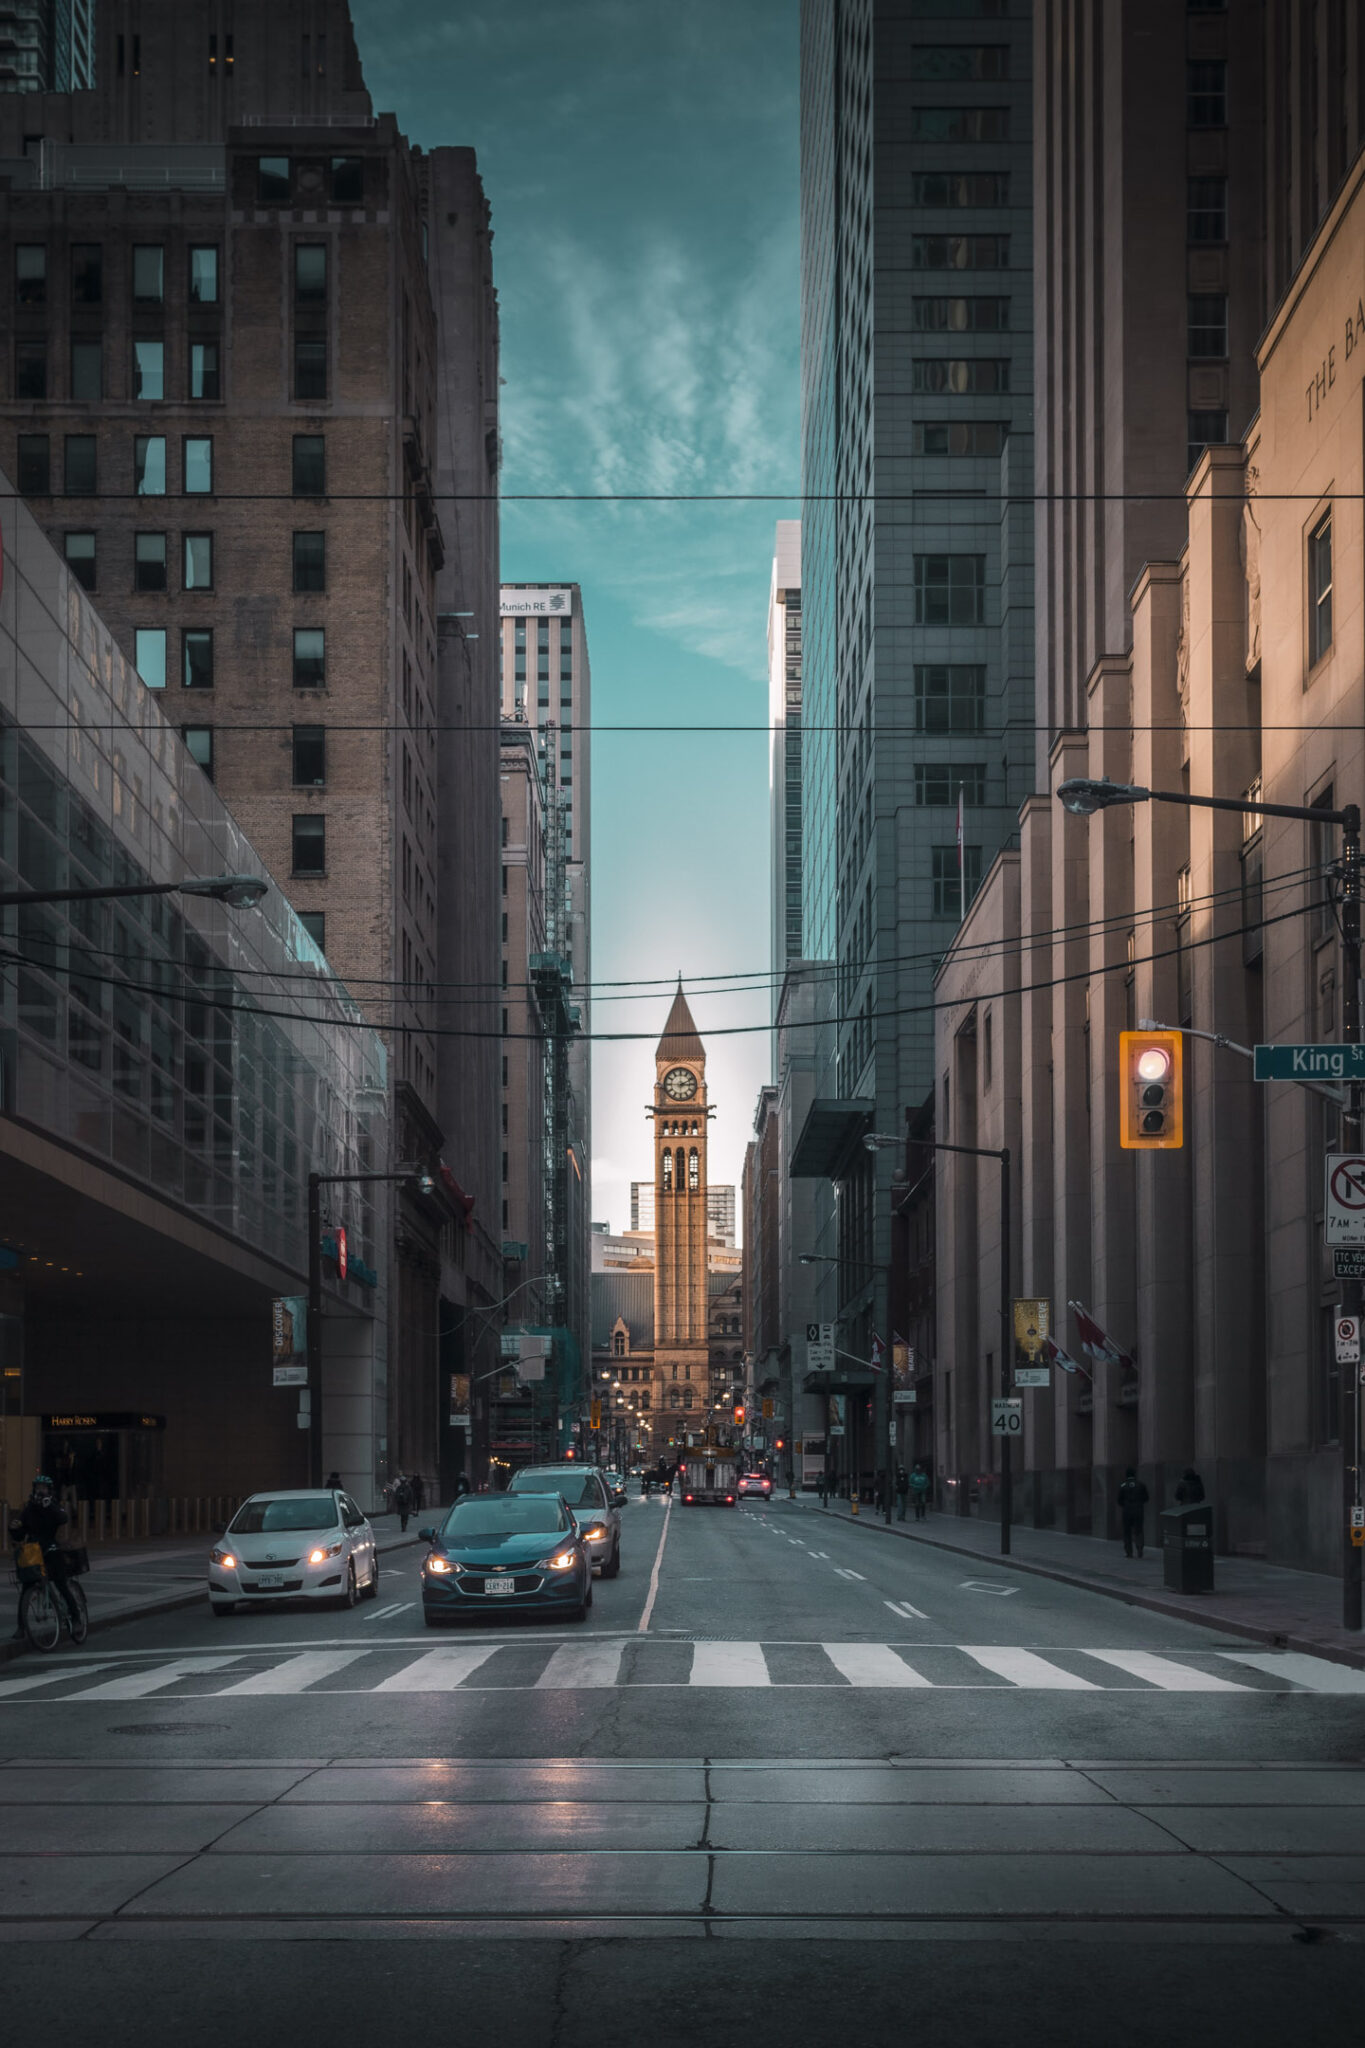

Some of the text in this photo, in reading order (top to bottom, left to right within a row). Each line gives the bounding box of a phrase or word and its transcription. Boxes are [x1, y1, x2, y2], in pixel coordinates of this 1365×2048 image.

[1305, 296, 1365, 423] THE BA
[533, 602, 545, 611] RE
[1293, 1048, 1364, 1077] King St
[1335, 1252, 1350, 1263] TTC
[274, 1302, 284, 1346] DISCOVER
[1038, 1301, 1047, 1341] ACHIEVE
[907, 1346, 915, 1371] BEAUTY
[994, 1414, 1020, 1431] 40
